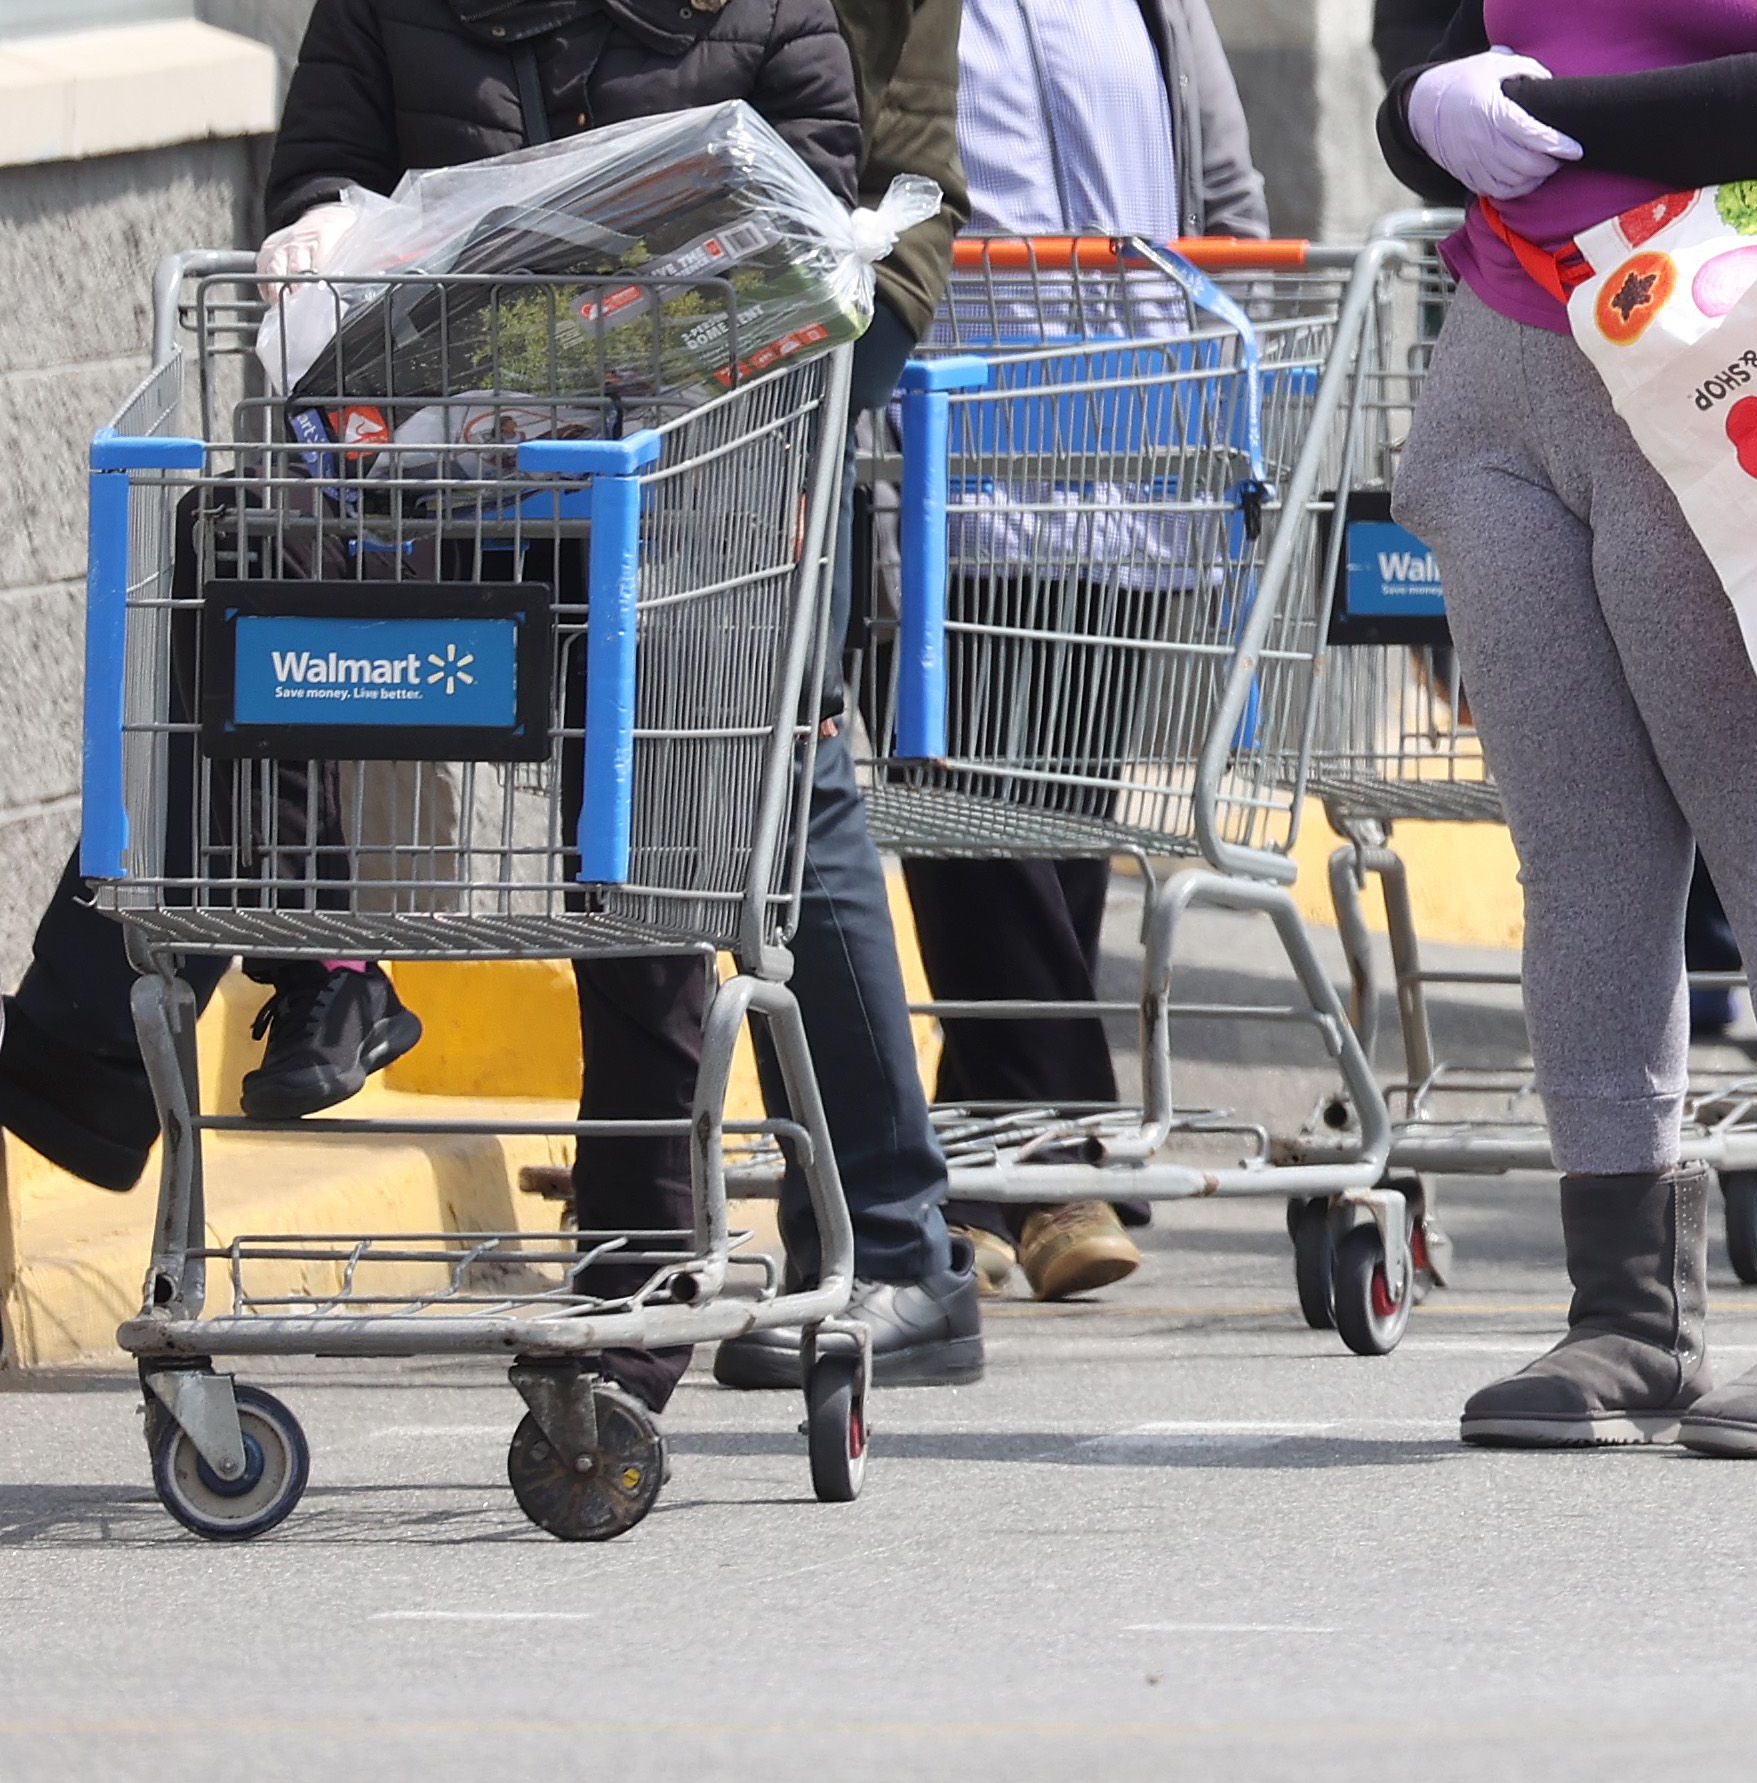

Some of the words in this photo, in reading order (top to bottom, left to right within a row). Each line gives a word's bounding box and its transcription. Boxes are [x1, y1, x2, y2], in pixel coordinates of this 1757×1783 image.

[687, 322, 730, 349] DOME
[271, 650, 421, 685] Walmart
[274, 686, 305, 699] Save
[306, 689, 351, 701] money.
[353, 687, 378, 699] Live
[380, 688, 424, 700] better.
